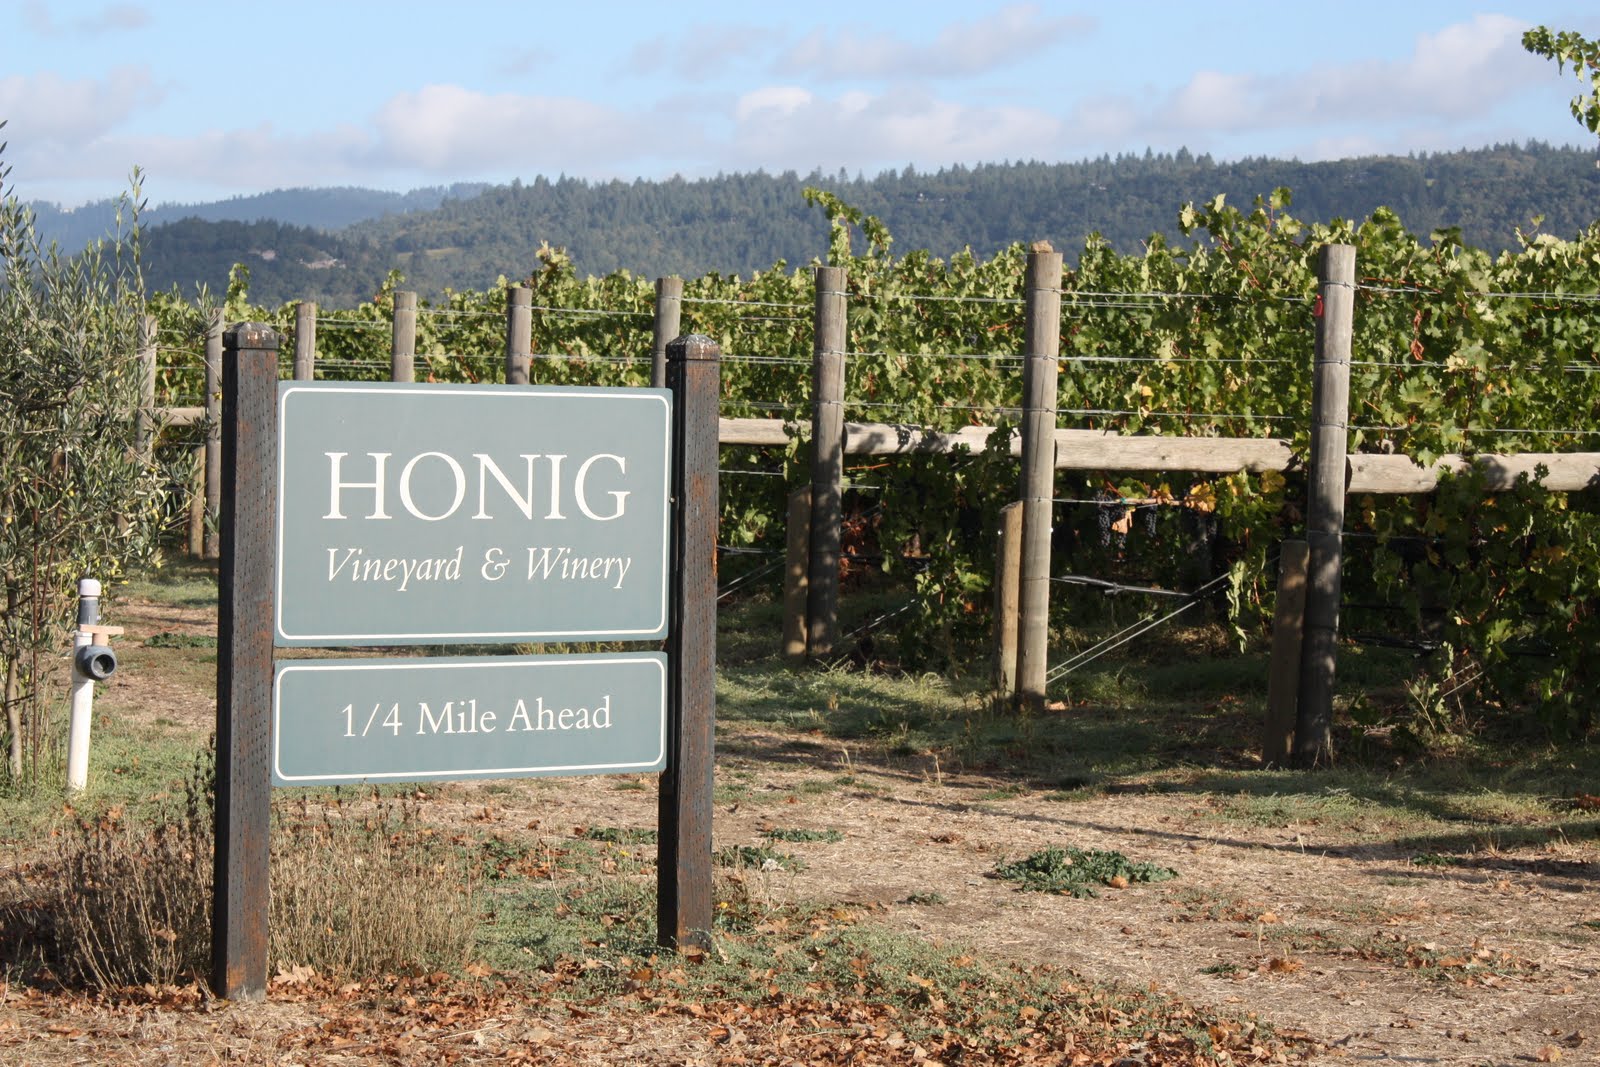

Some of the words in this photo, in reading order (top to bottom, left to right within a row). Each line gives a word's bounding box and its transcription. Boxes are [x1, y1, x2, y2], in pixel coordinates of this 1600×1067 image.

[322, 451, 631, 521] HONIG
[326, 546, 464, 592] Vineyard
[480, 547, 511, 581] &
[526, 546, 632, 590] Winery
[341, 702, 403, 737] 1/4
[415, 699, 497, 735] Mile
[505, 695, 613, 731] Ahead
